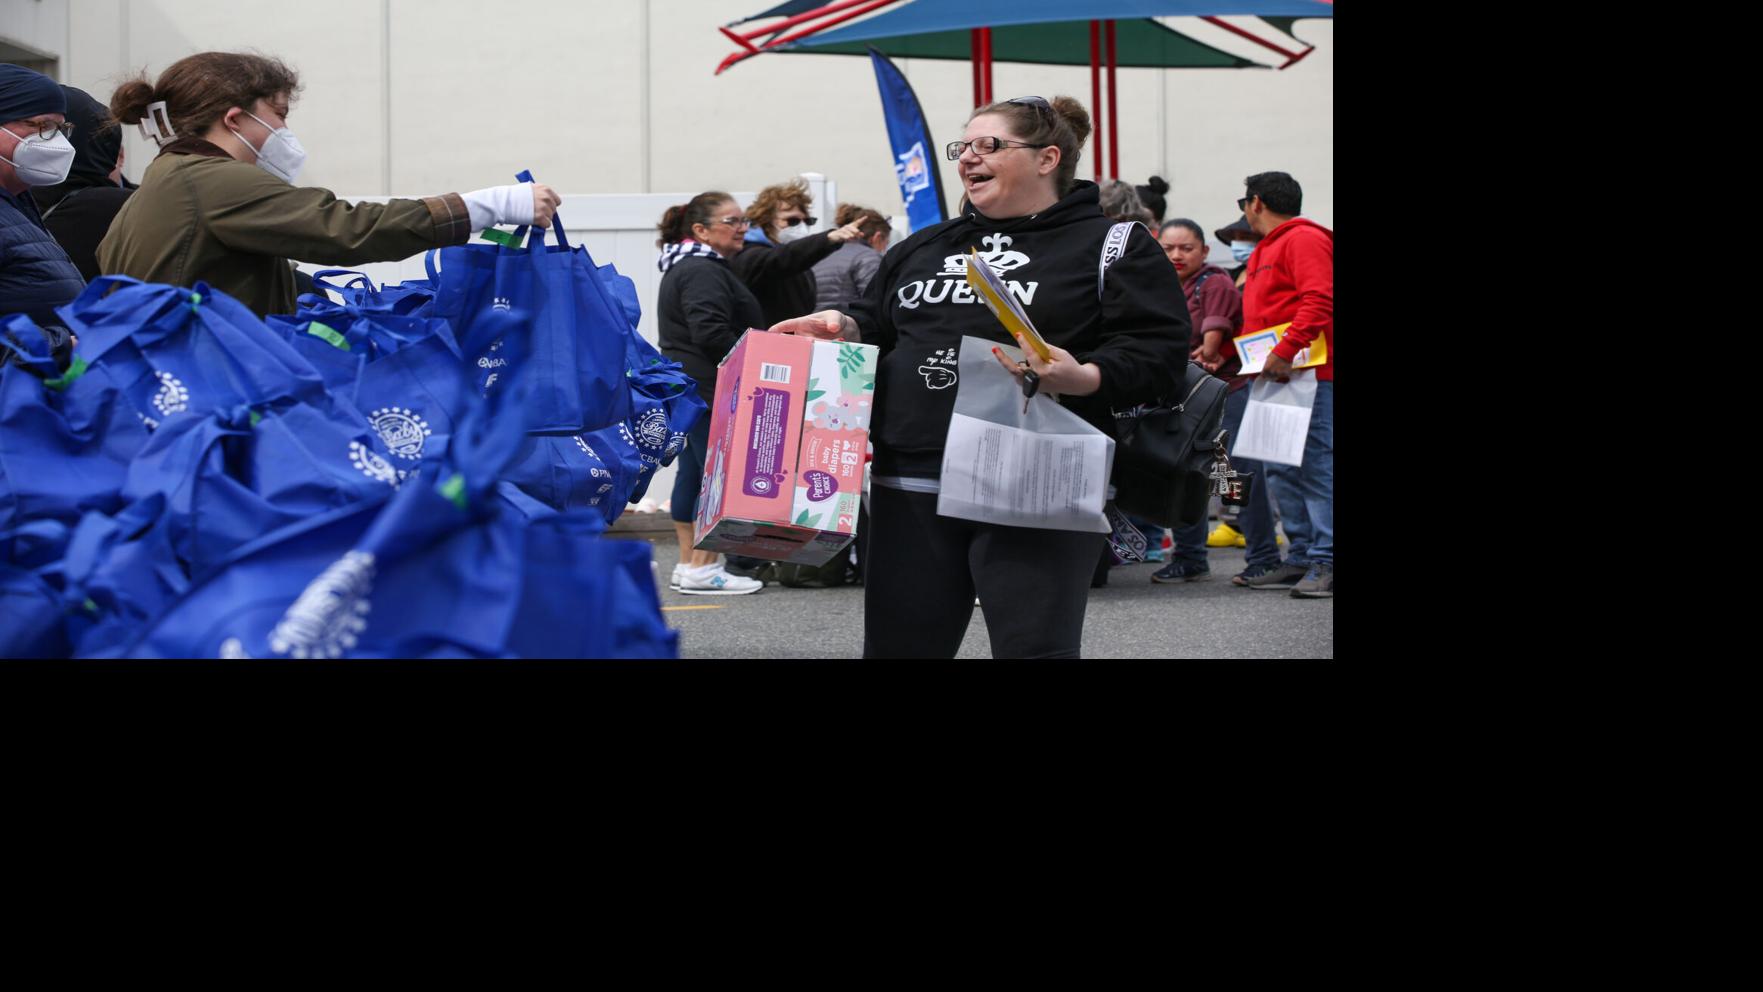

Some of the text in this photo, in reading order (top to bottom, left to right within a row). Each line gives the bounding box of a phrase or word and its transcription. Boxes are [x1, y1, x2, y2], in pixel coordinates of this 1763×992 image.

[897, 279, 1039, 309] QUEN
[822, 446, 831, 464] baby
[828, 439, 840, 474] diapers
[846, 455, 857, 463] 2
[842, 464, 850, 476] 160
[810, 472, 824, 498] Parent's
[823, 476, 831, 494] CHOICE
[838, 516, 852, 526] 2
